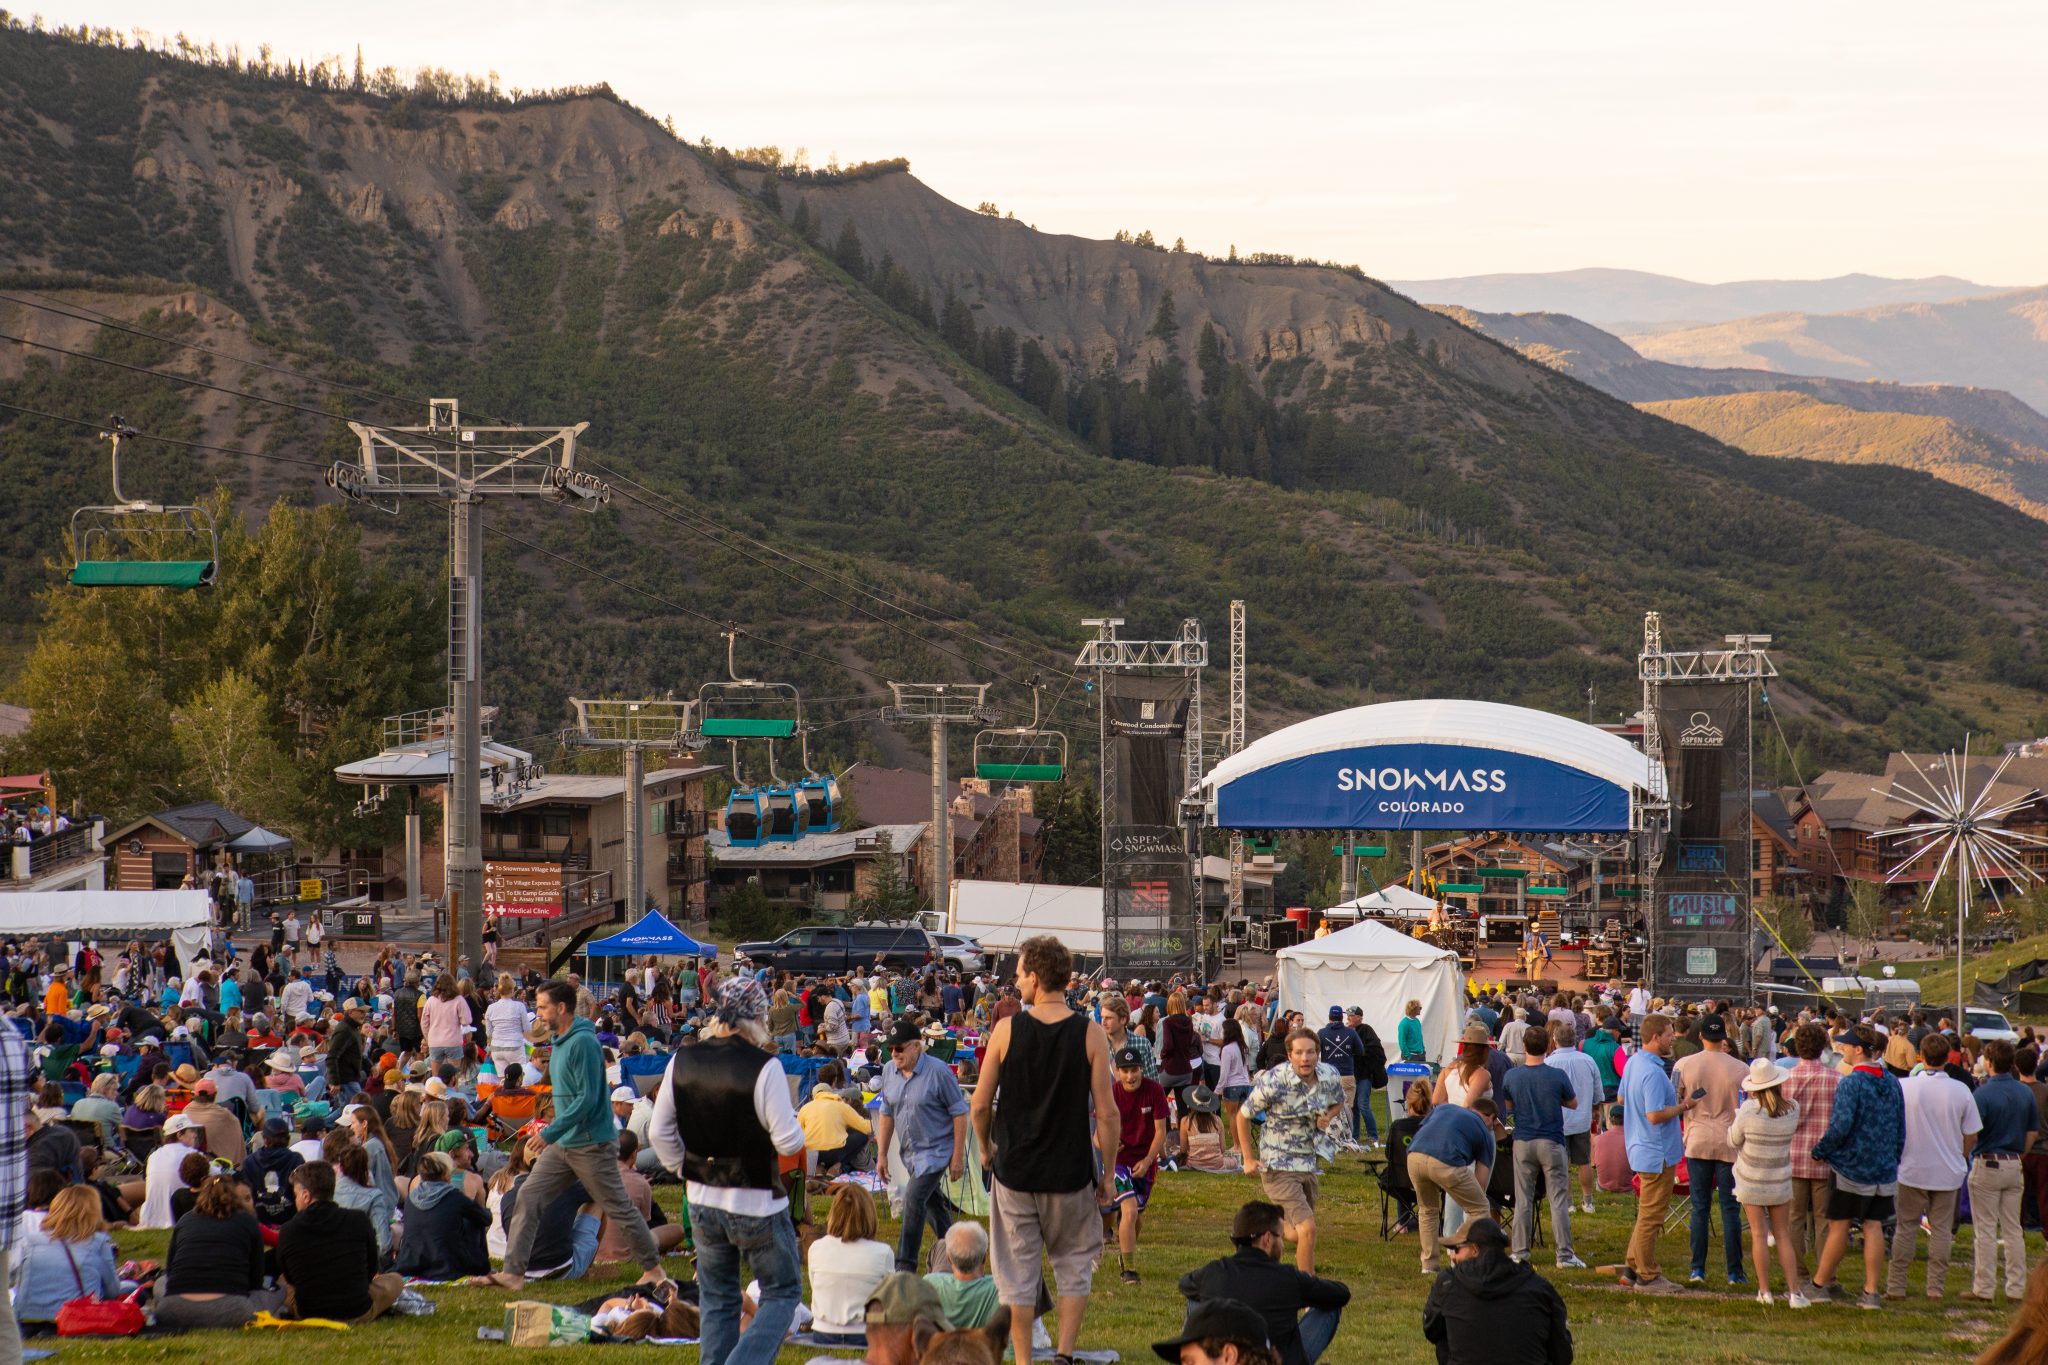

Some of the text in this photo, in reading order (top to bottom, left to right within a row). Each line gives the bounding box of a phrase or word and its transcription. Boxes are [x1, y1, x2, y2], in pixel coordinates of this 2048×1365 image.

[1337, 767, 1507, 793] SNOWMASS
[1378, 801, 1465, 814] COLORADO
[1124, 835, 1160, 844] ASPEN
[1124, 844, 1184, 854] SNOWMASS
[1673, 895, 1735, 914] MUSIC
[357, 914, 373, 925] EXIT
